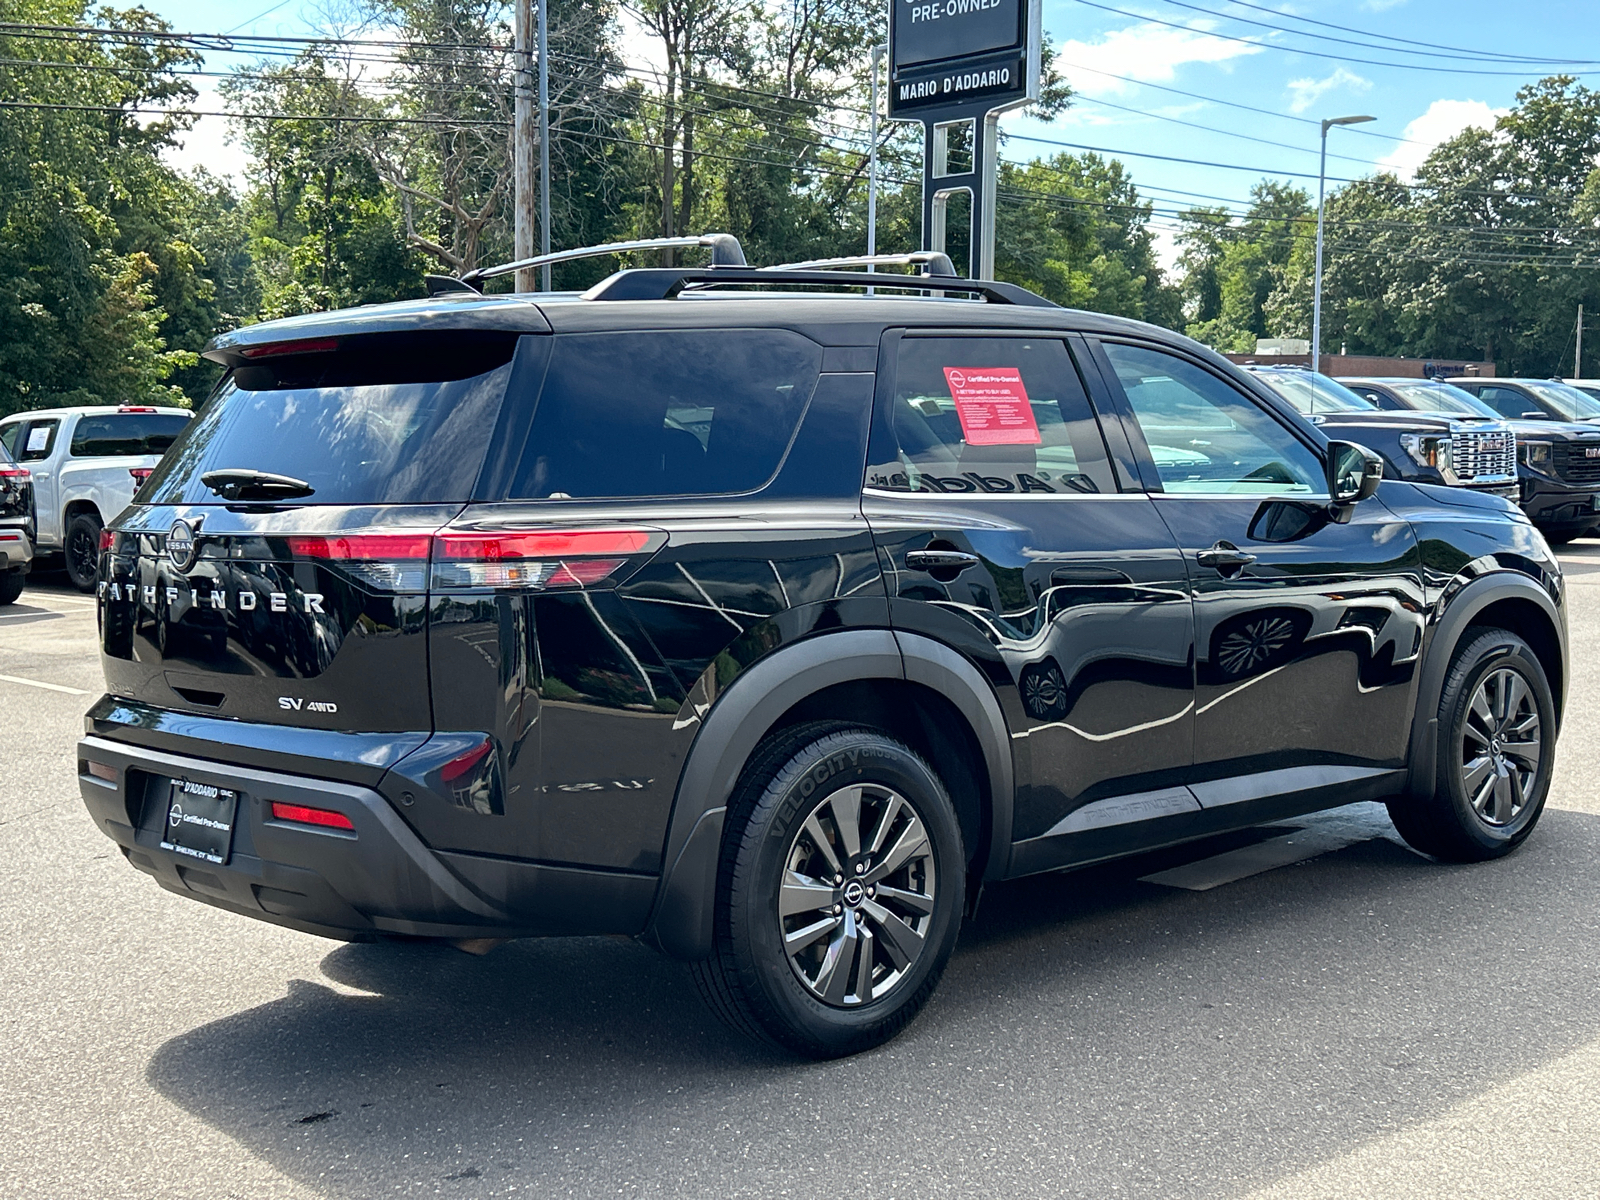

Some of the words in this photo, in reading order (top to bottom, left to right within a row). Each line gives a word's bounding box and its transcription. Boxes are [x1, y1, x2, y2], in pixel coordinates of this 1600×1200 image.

[912, 0, 1000, 23] PRE-OWNED
[900, 80, 937, 100] MARIO
[943, 68, 1010, 94] D'ADDARIO
[99, 581, 325, 614] PATHFINDER
[279, 697, 303, 710] SV
[307, 702, 337, 713] 4WD
[184, 781, 218, 798] D'ADDARIO
[771, 748, 860, 838] VELOCITY
[861, 748, 898, 761] CROSS
[1085, 794, 1194, 822] PATHFINDER
